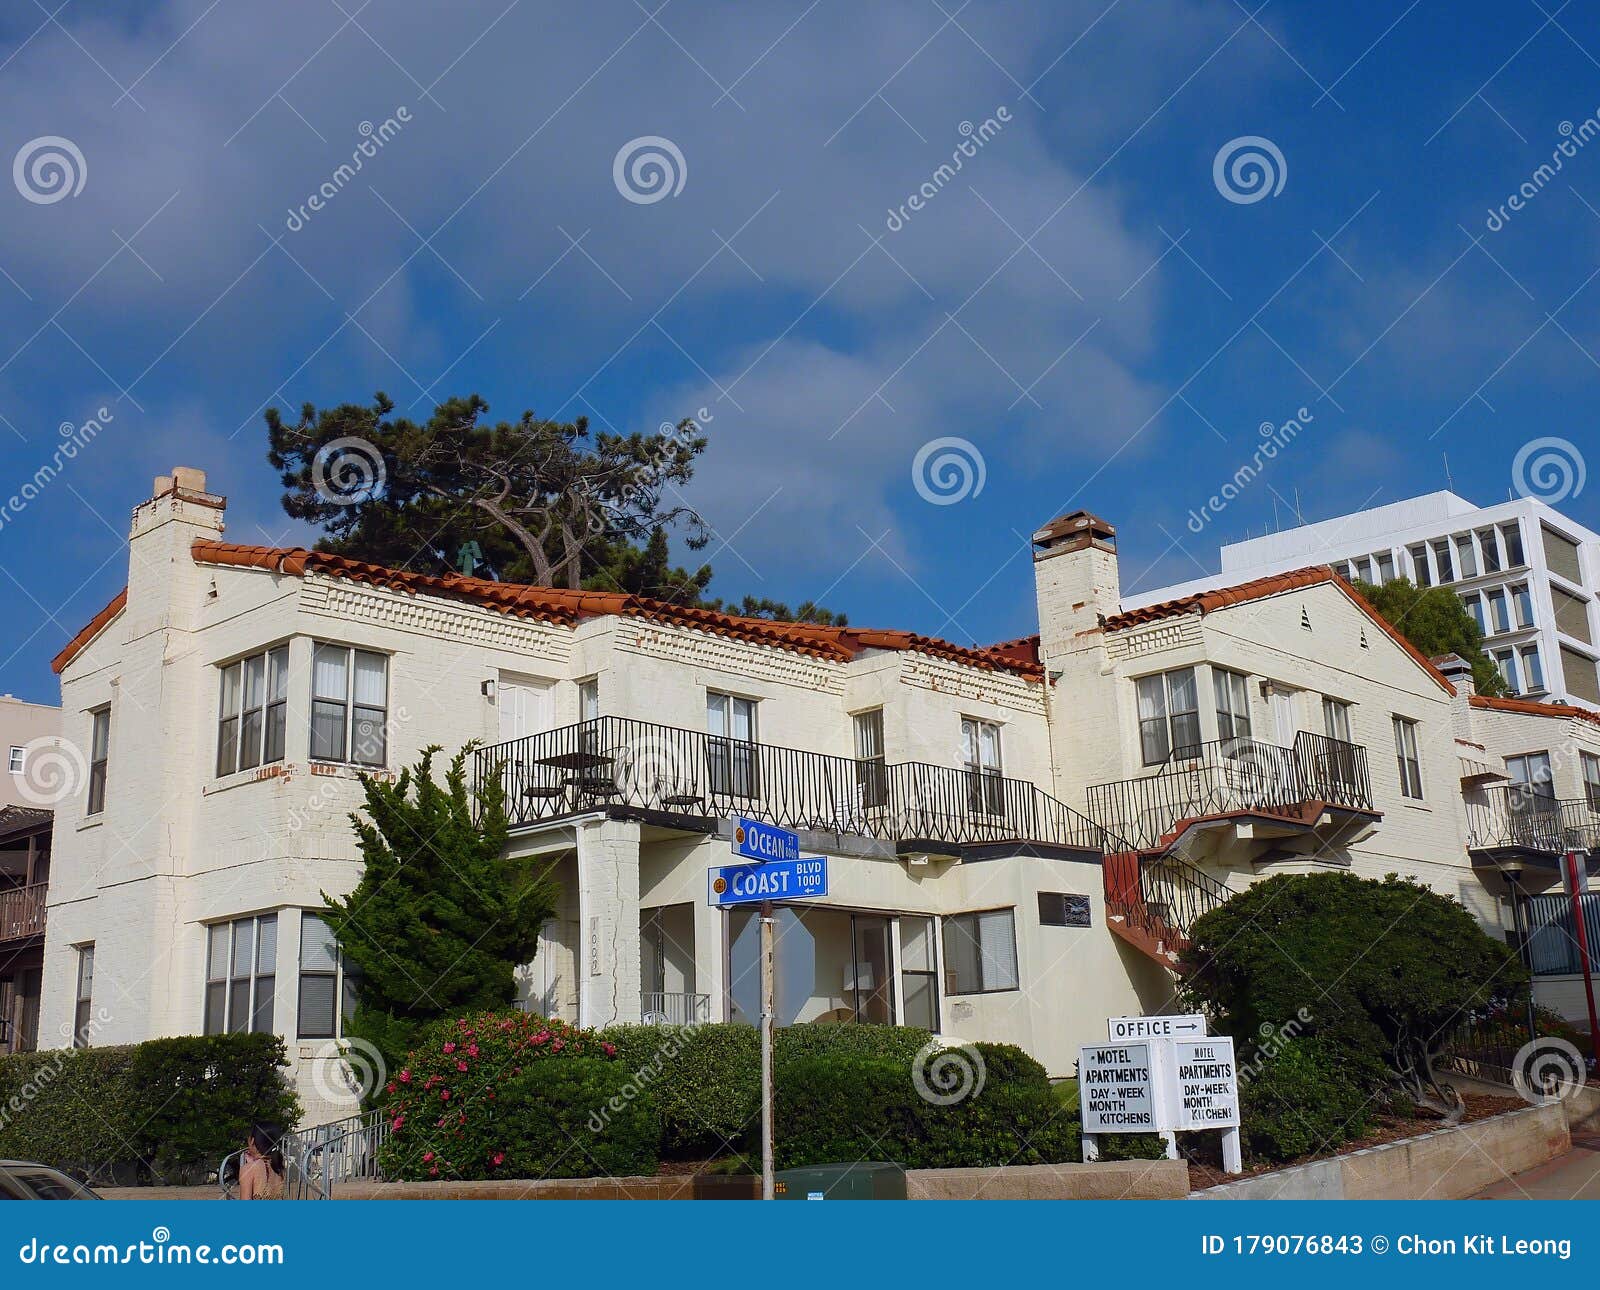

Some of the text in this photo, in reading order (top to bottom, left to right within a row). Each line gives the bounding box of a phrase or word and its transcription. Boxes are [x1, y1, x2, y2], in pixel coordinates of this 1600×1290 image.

[748, 826, 785, 859] OCEAN
[732, 862, 821, 896] COAST BLVD
[797, 874, 821, 887] 1000
[1116, 1021, 1171, 1036] OFFICE
[1097, 1049, 1131, 1064] MOTEL
[1194, 1048, 1215, 1058] MOTEL
[1085, 1067, 1148, 1083] APARTMENTS
[1179, 1063, 1231, 1080] APARTMENTS
[1089, 1101, 1126, 1112] MONTH
[1183, 1097, 1213, 1109] MONTH
[1100, 1112, 1150, 1124] KITCHENS
[1191, 1108, 1232, 1121] KITCHENS
